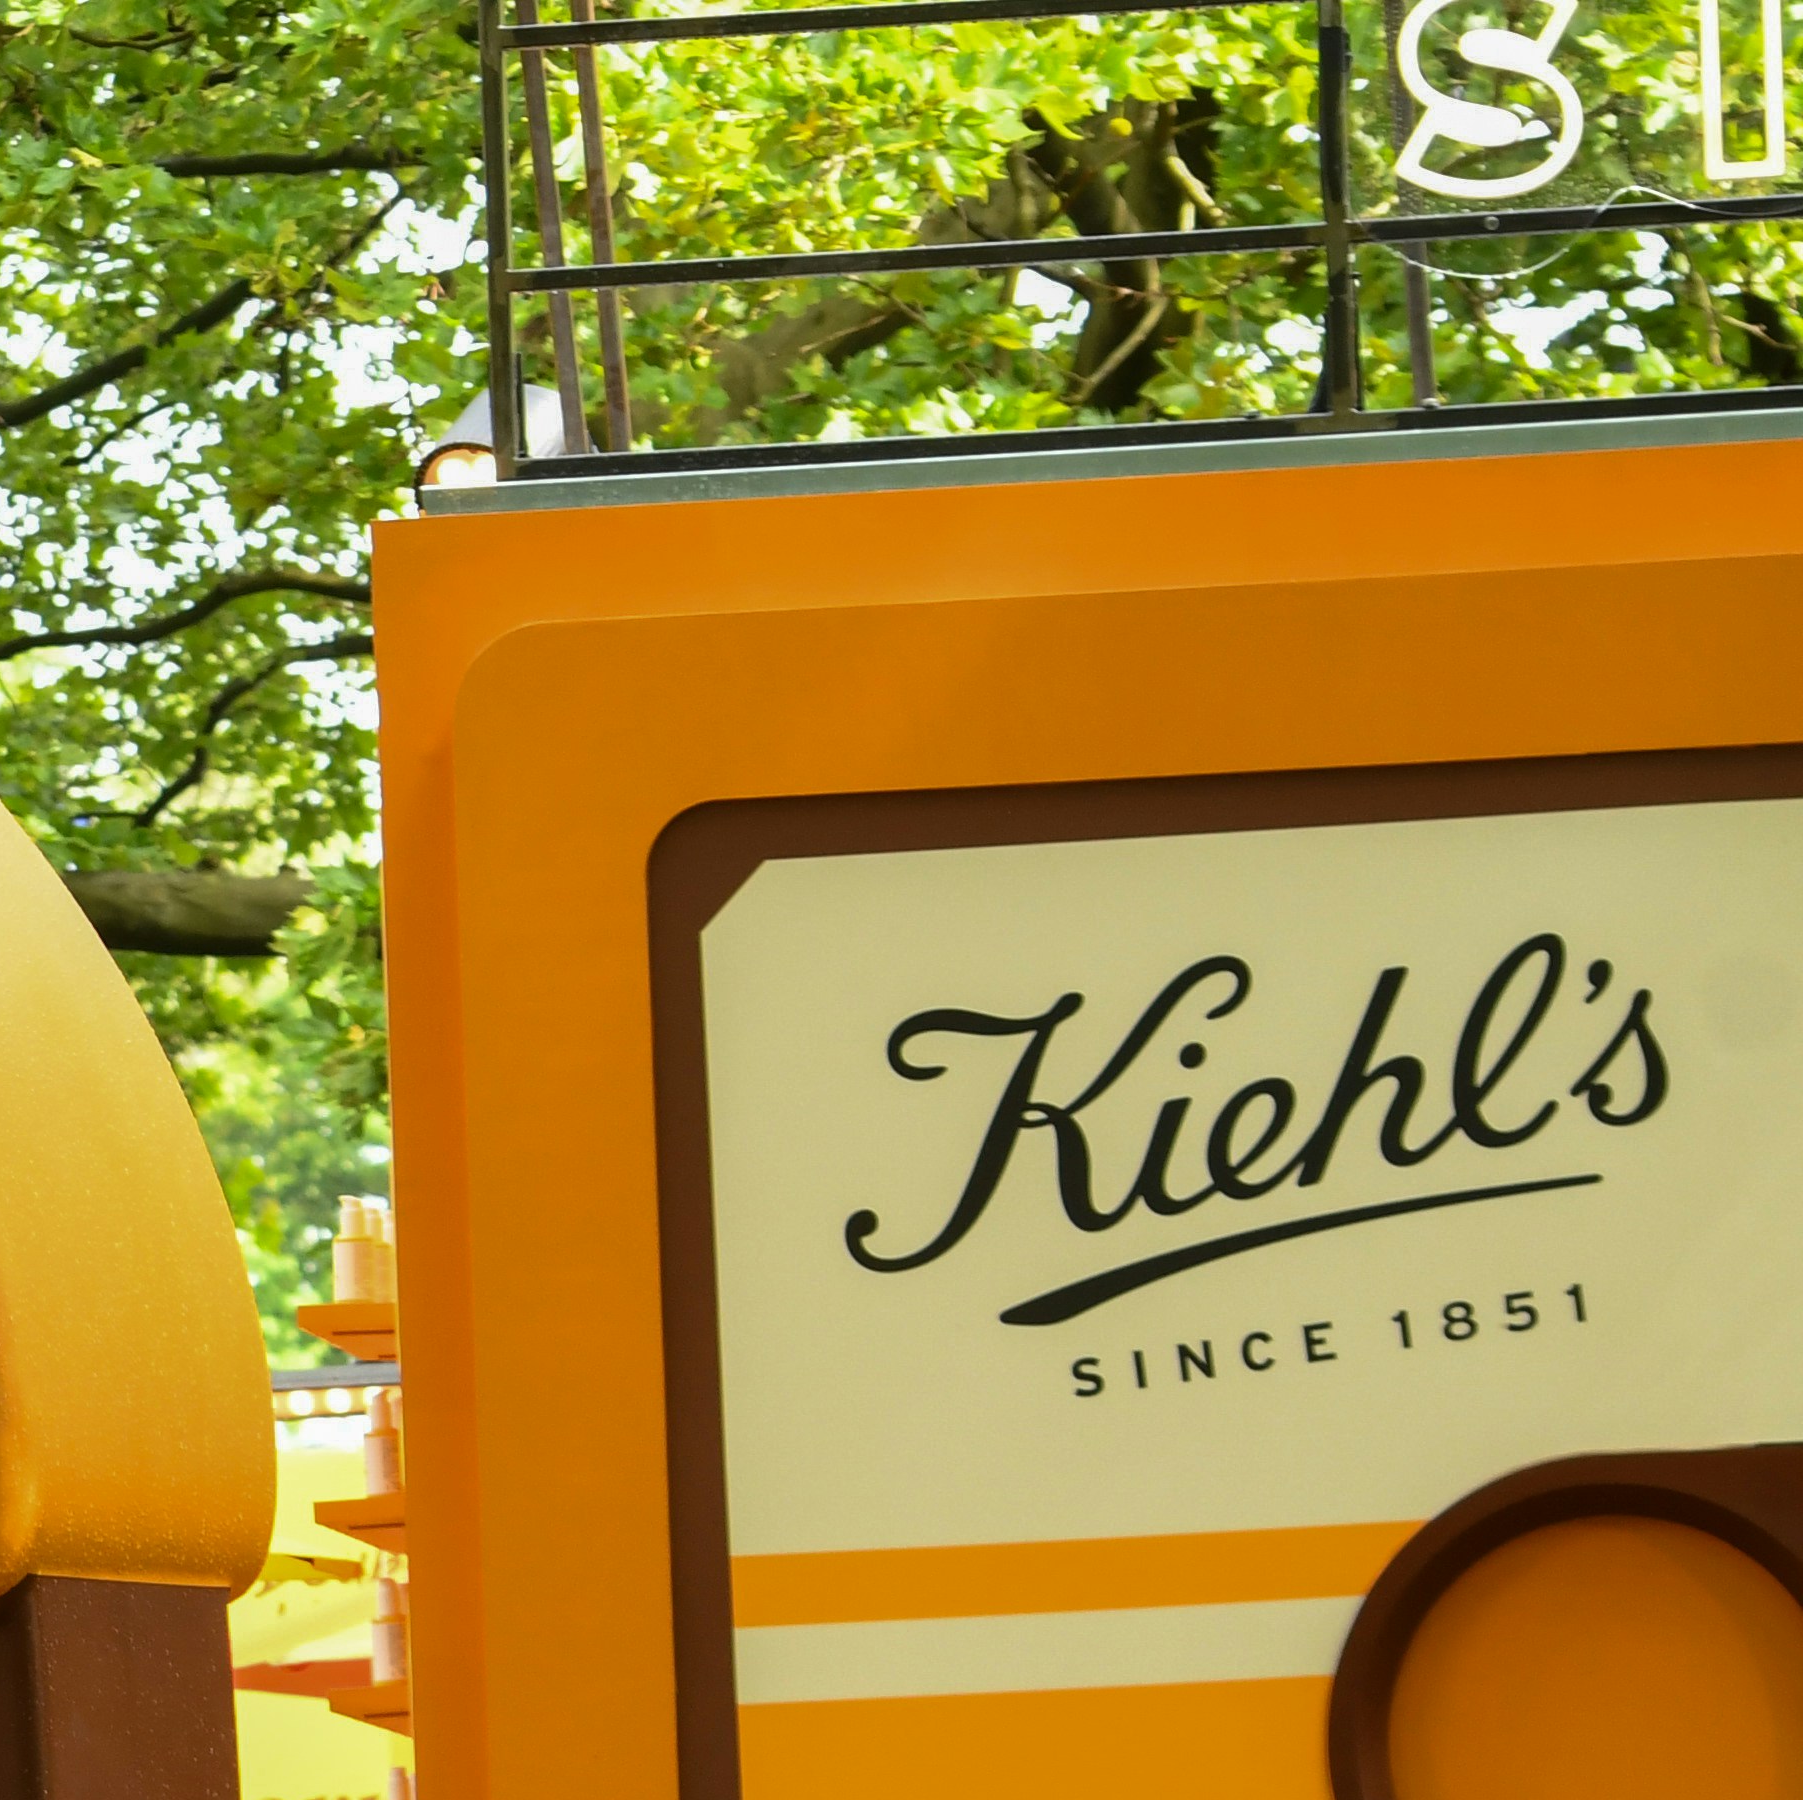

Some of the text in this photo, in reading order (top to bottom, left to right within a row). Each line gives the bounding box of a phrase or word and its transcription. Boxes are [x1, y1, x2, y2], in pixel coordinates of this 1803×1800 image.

[844, 932, 1670, 1274] Kiehl's
[1070, 1283, 1589, 1398] SINCE 1851
